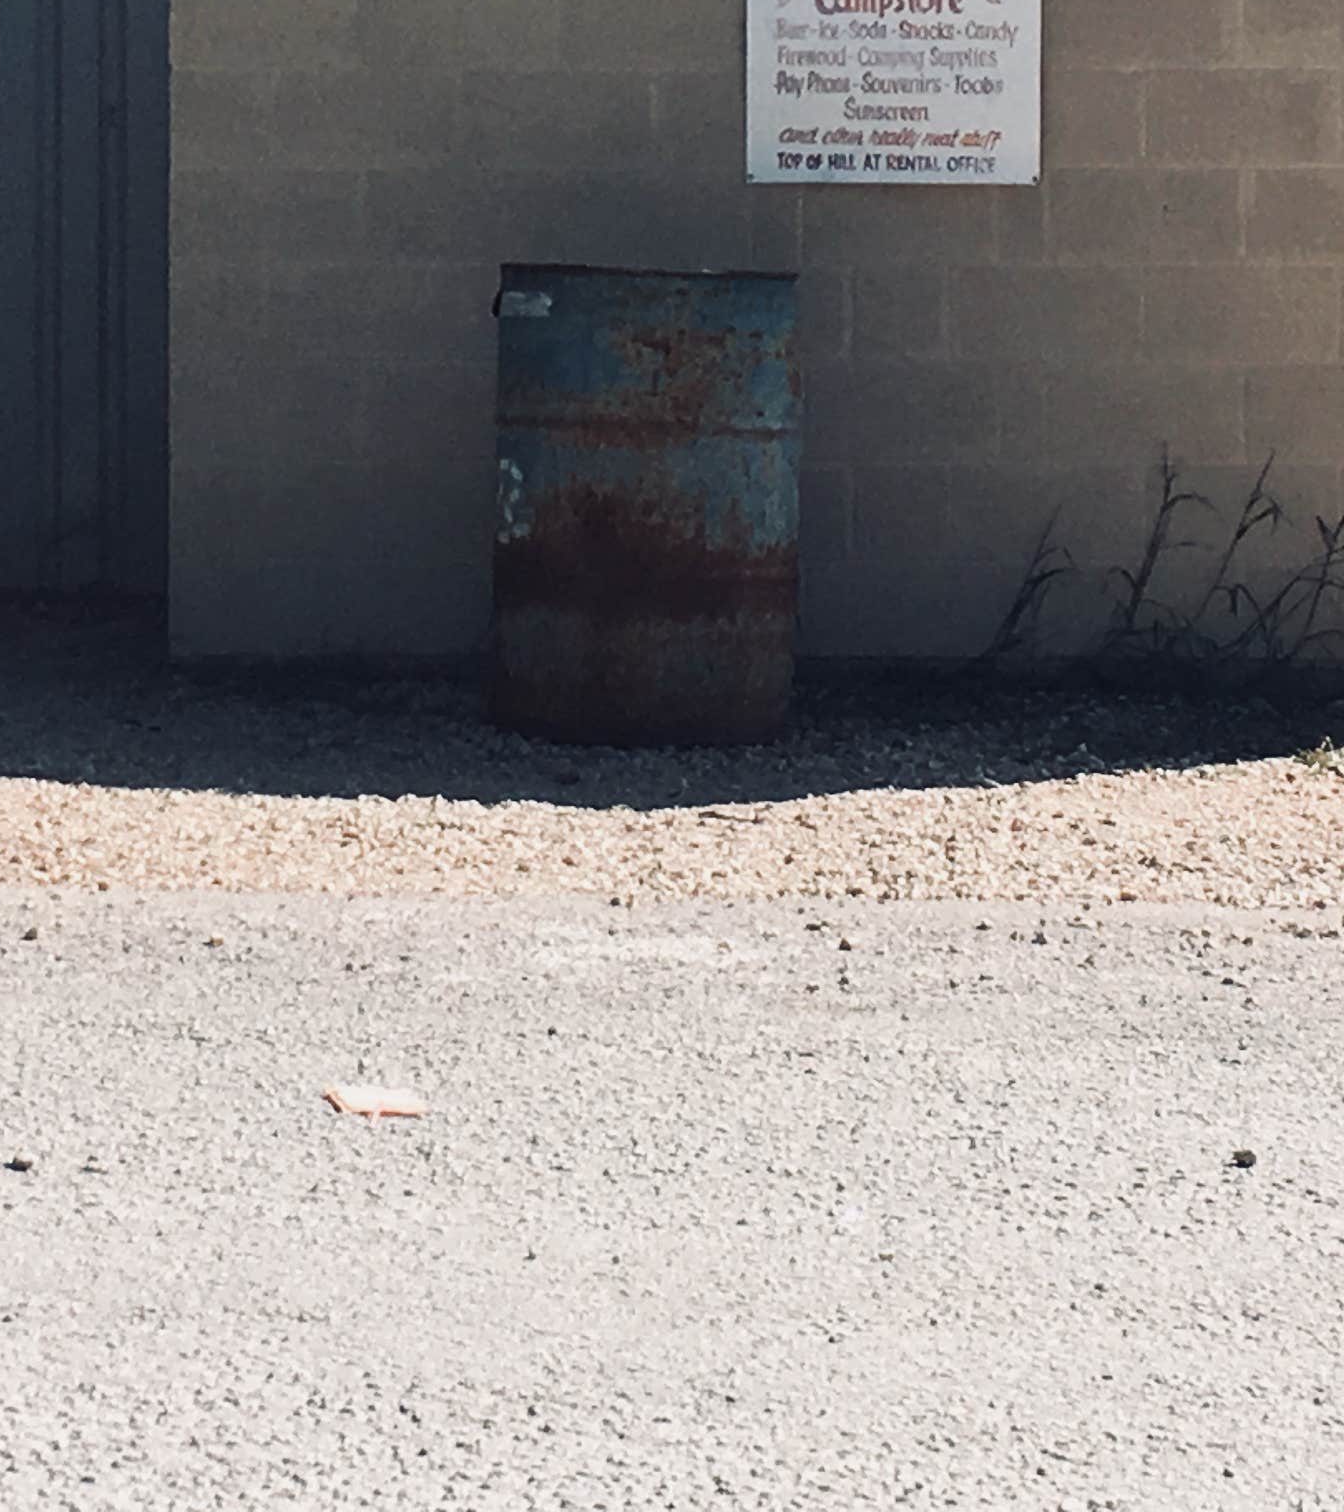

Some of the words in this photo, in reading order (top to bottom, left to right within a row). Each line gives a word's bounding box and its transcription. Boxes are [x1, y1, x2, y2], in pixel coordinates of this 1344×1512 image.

[849, 20, 887, 39] Soda
[899, 20, 955, 39] Snacks
[965, 20, 1018, 47] Candy
[777, 45, 846, 67] Firewood
[930, 46, 998, 71] Supplies
[860, 71, 941, 94] Souvenirs
[843, 96, 929, 122] Sunscreen
[777, 152, 803, 170] TOP
[806, 153, 822, 170] OF
[828, 152, 856, 170] HILL
[863, 153, 881, 171] AT
[885, 153, 941, 172] RENTAL
[946, 155, 997, 174] OFFICE
